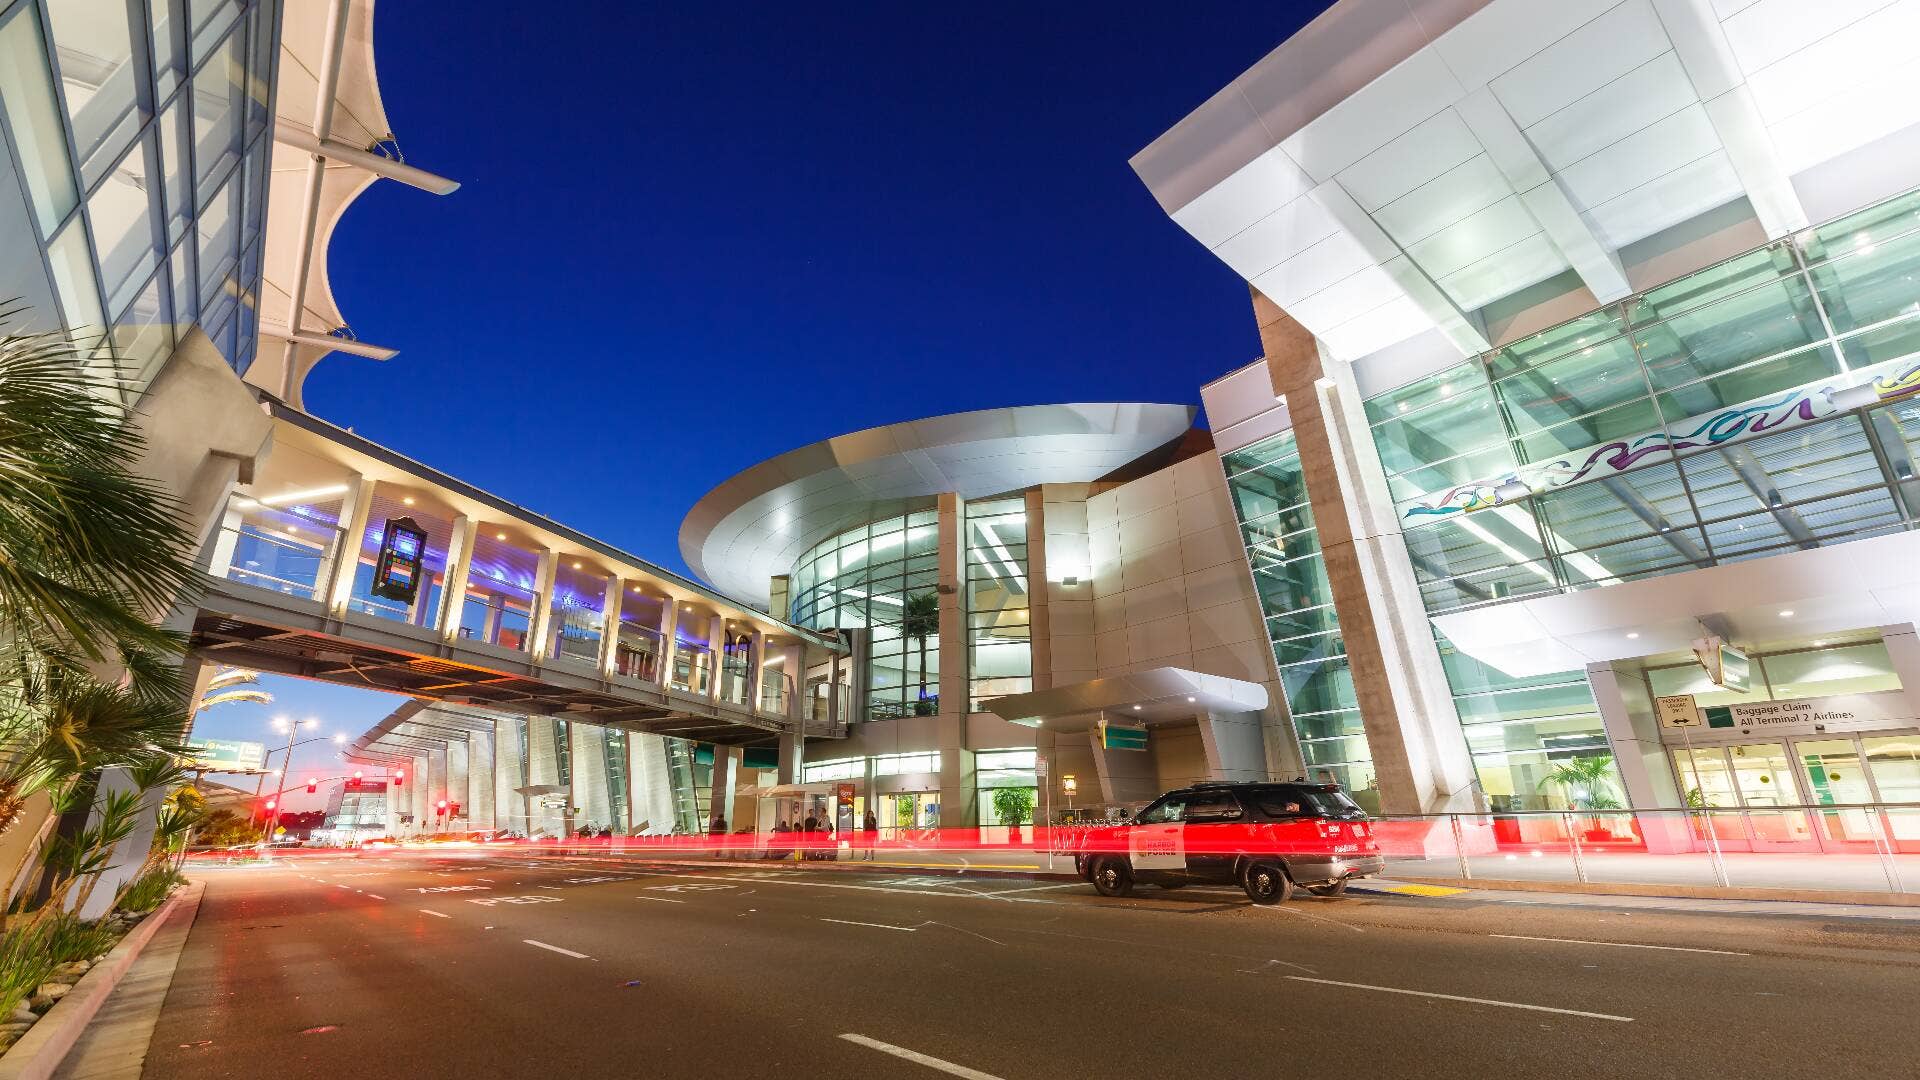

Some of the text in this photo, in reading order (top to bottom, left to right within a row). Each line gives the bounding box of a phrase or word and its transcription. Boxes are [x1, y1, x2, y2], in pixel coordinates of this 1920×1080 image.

[1736, 702, 1812, 717] Baggage Claim
[1741, 711, 1854, 726] All Terminal 2 Airlines
